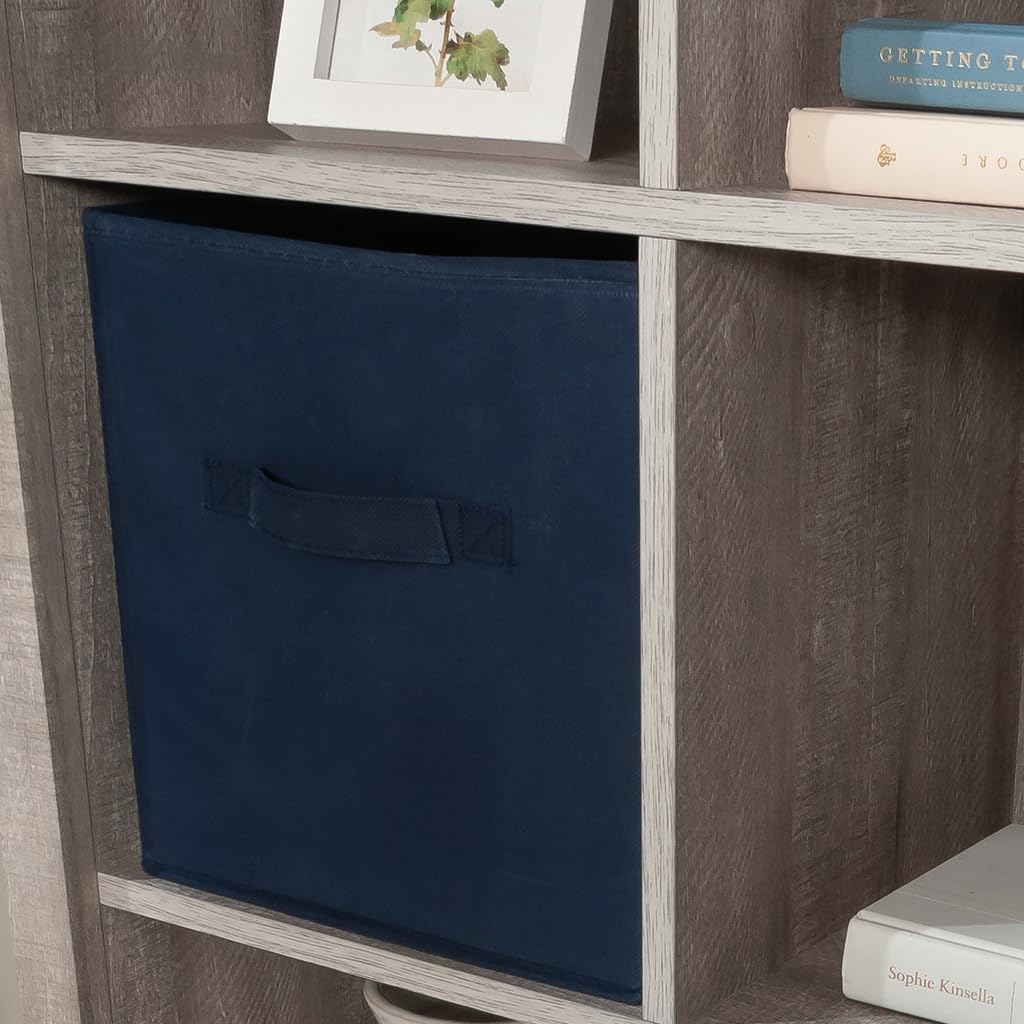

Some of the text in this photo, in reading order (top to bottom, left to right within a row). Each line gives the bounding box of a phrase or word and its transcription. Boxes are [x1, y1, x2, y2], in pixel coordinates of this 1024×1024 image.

[879, 46, 992, 71] GETTING
[888, 965, 995, 1006] Sophie Kinsella
